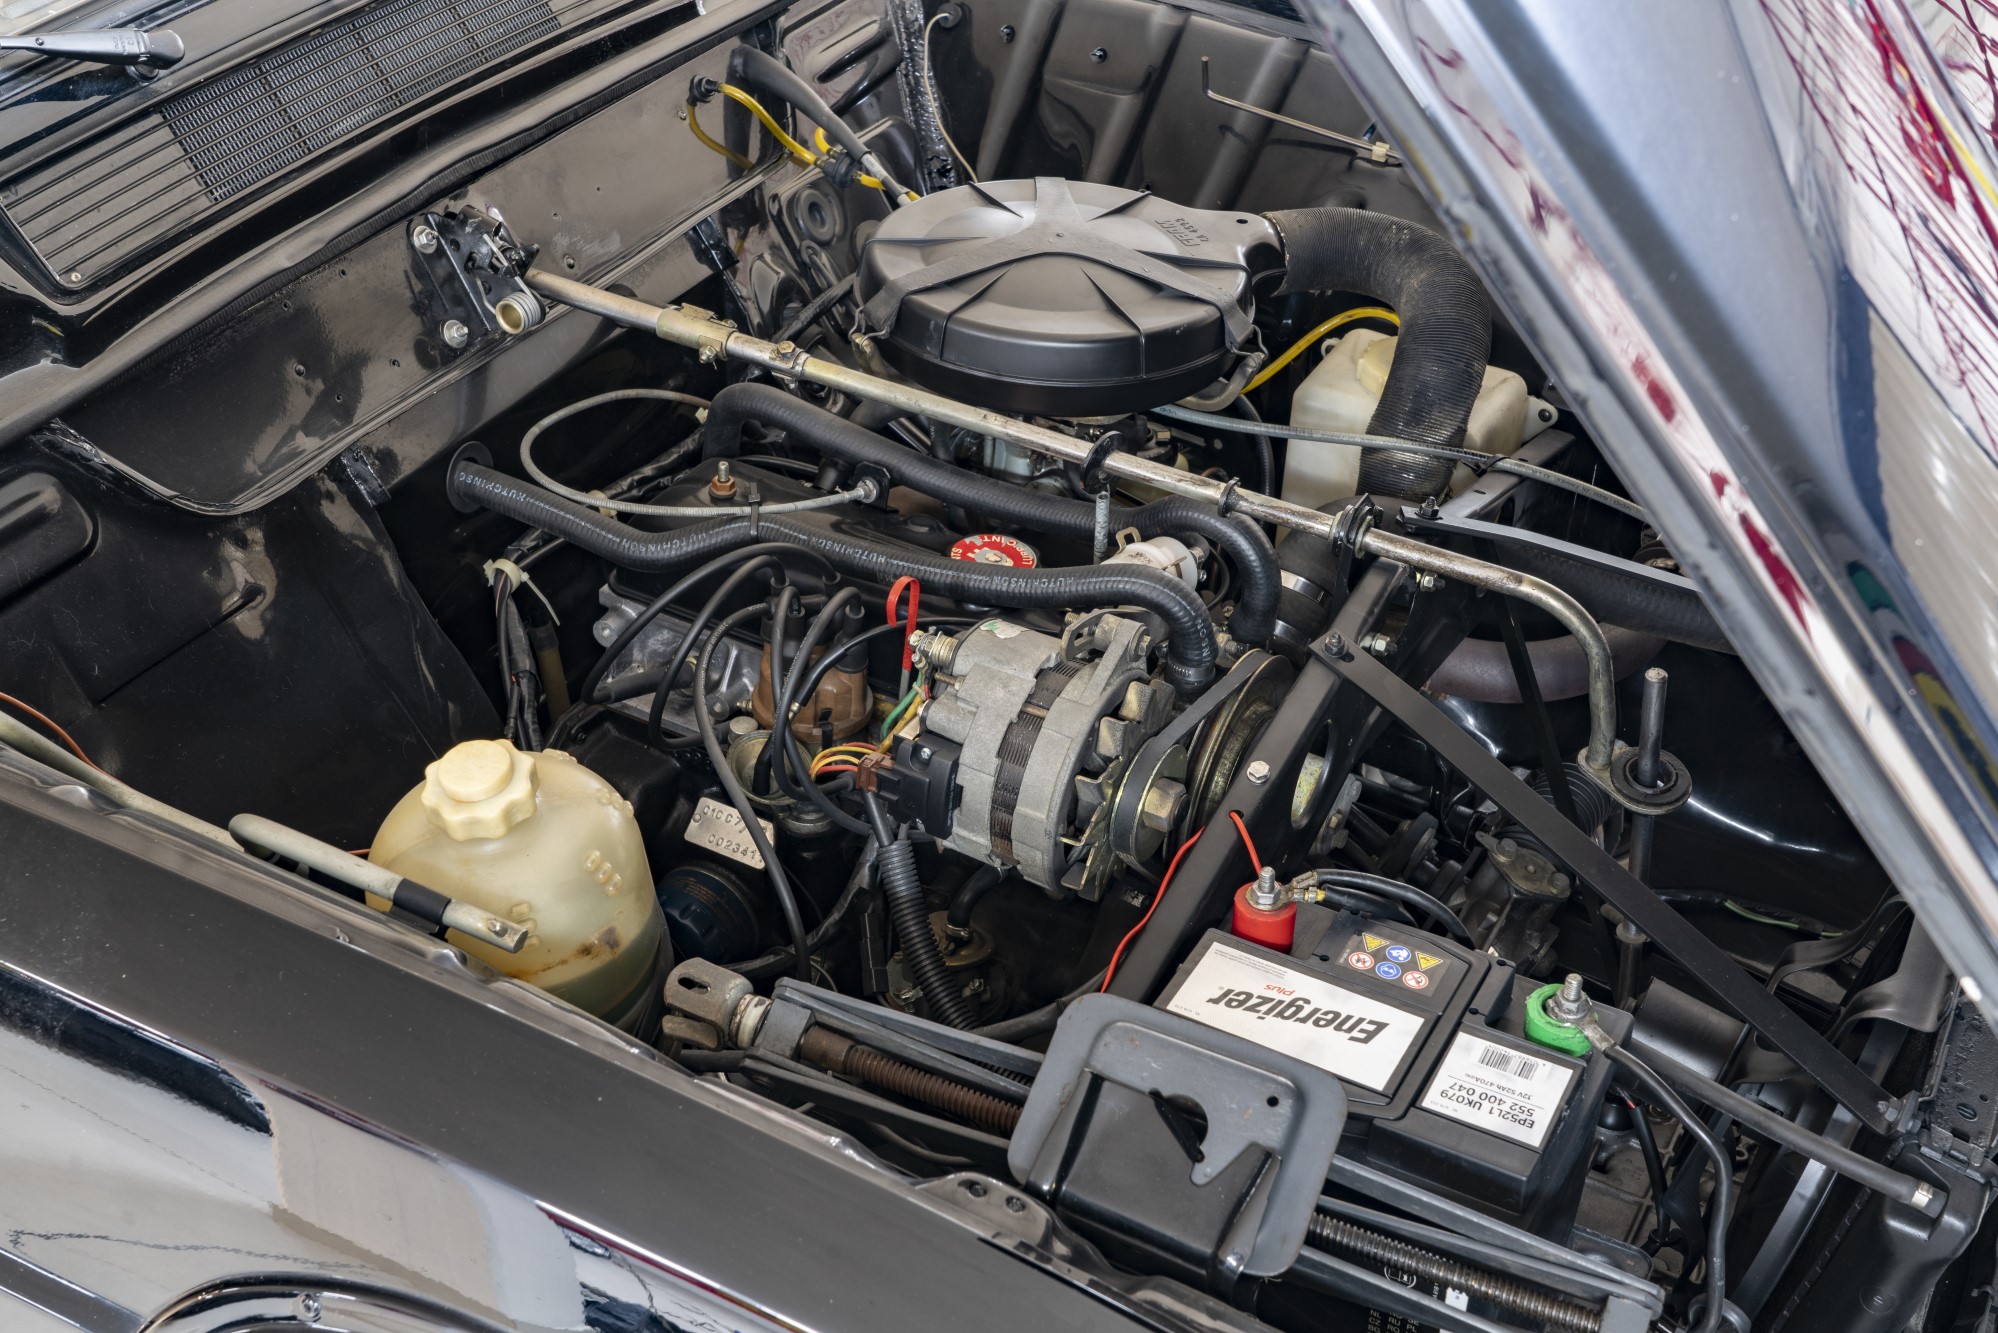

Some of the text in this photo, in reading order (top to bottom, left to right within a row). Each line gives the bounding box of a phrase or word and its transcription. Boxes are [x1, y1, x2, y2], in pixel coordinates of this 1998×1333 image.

[458, 471, 527, 502] HUTCHINSO
[621, 532, 706, 552] HUTCHINSON
[810, 536, 887, 563] HUTCHINSON
[1206, 987, 1390, 1044] Energizer
[1440, 1089, 1483, 1111] UK079
[1449, 1082, 1536, 1117] 552 400 047
[1496, 1083, 1516, 1096] 52Ah
[1517, 1091, 1533, 1101] 12V
[1488, 1104, 1536, 1129] EP52L1
[1369, 1317, 1380, 1326] CZ
[1388, 1317, 1400, 1326] RU
[1406, 1324, 1417, 1332] PL
